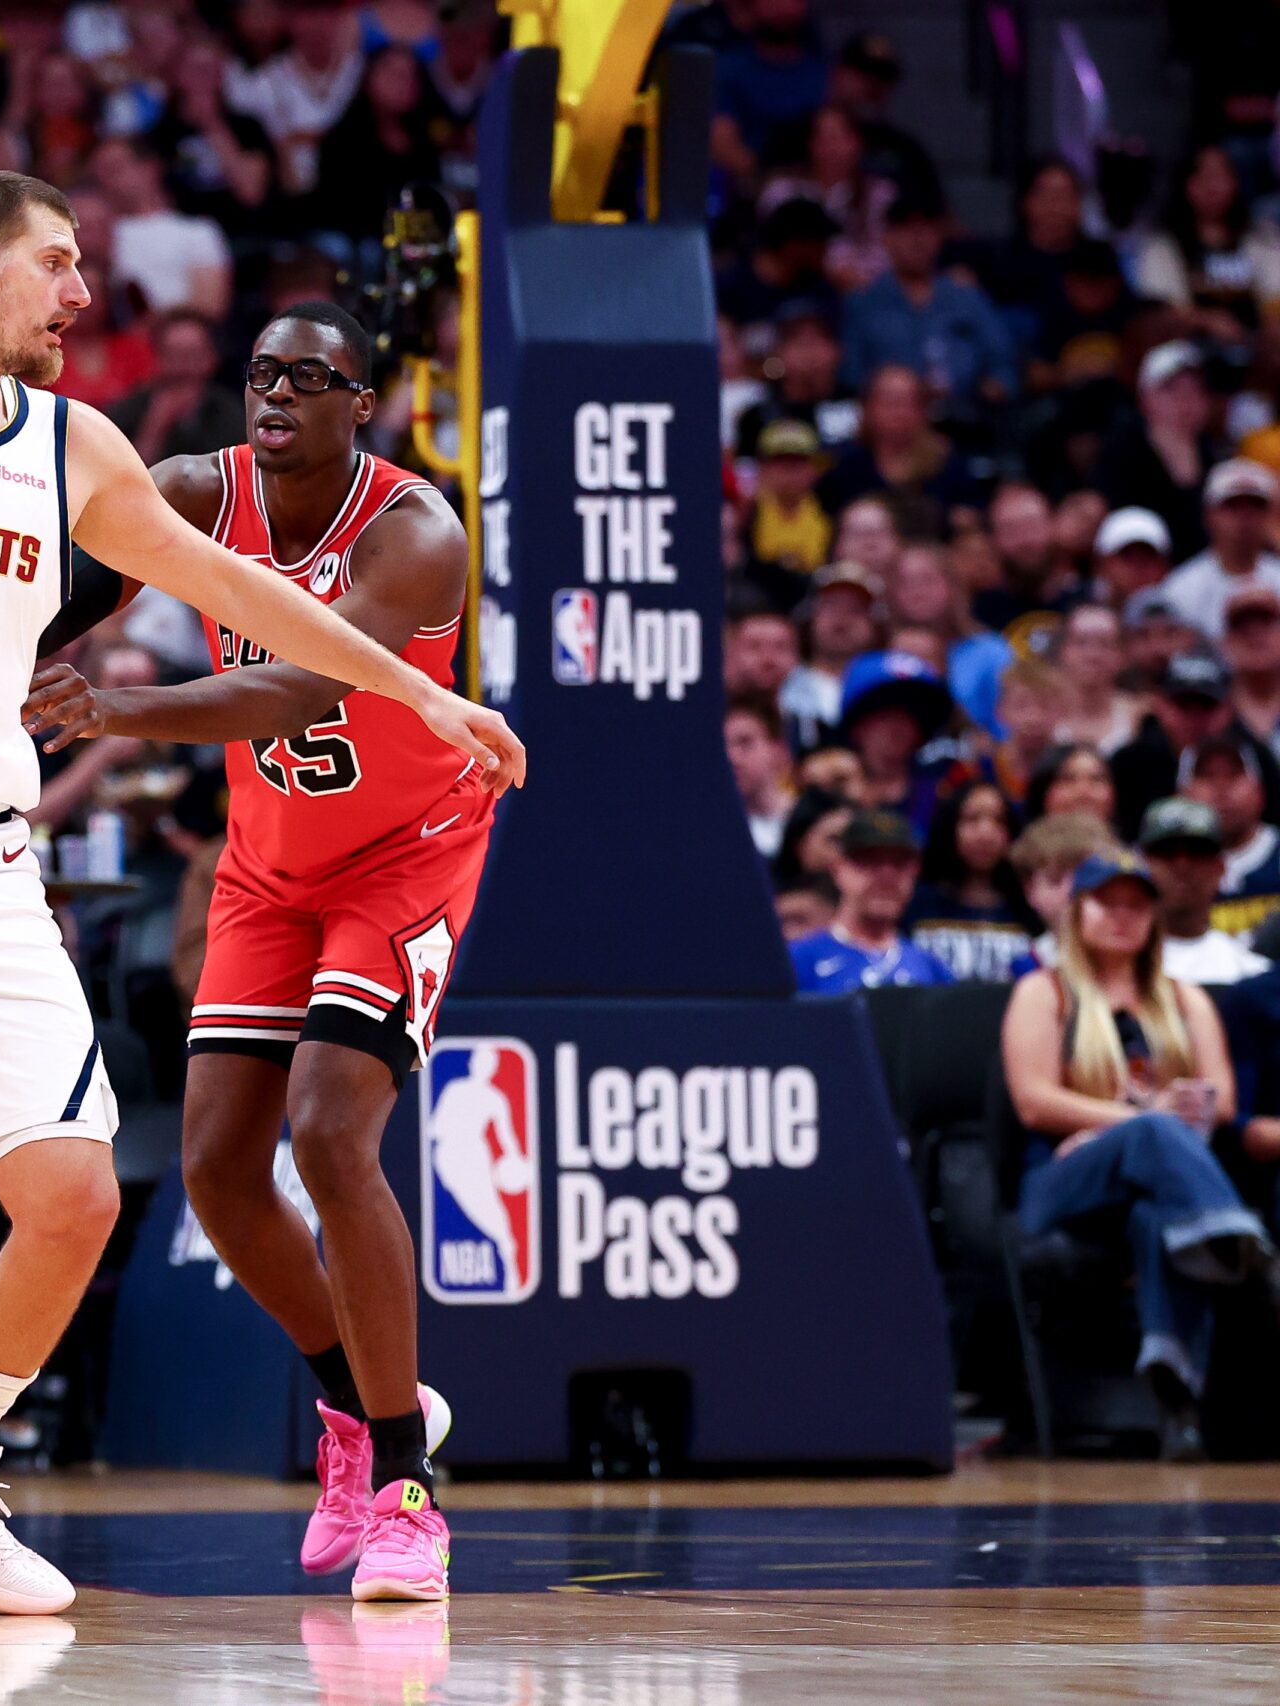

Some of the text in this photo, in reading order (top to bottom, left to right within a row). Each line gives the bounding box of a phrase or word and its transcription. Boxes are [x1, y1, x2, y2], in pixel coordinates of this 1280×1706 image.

[574, 401, 675, 490] GET
[574, 495, 677, 584] THE
[599, 590, 703, 701] App
[554, 1041, 819, 1192] League
[440, 1239, 496, 1285] NBA
[557, 1171, 740, 1299] Pass
